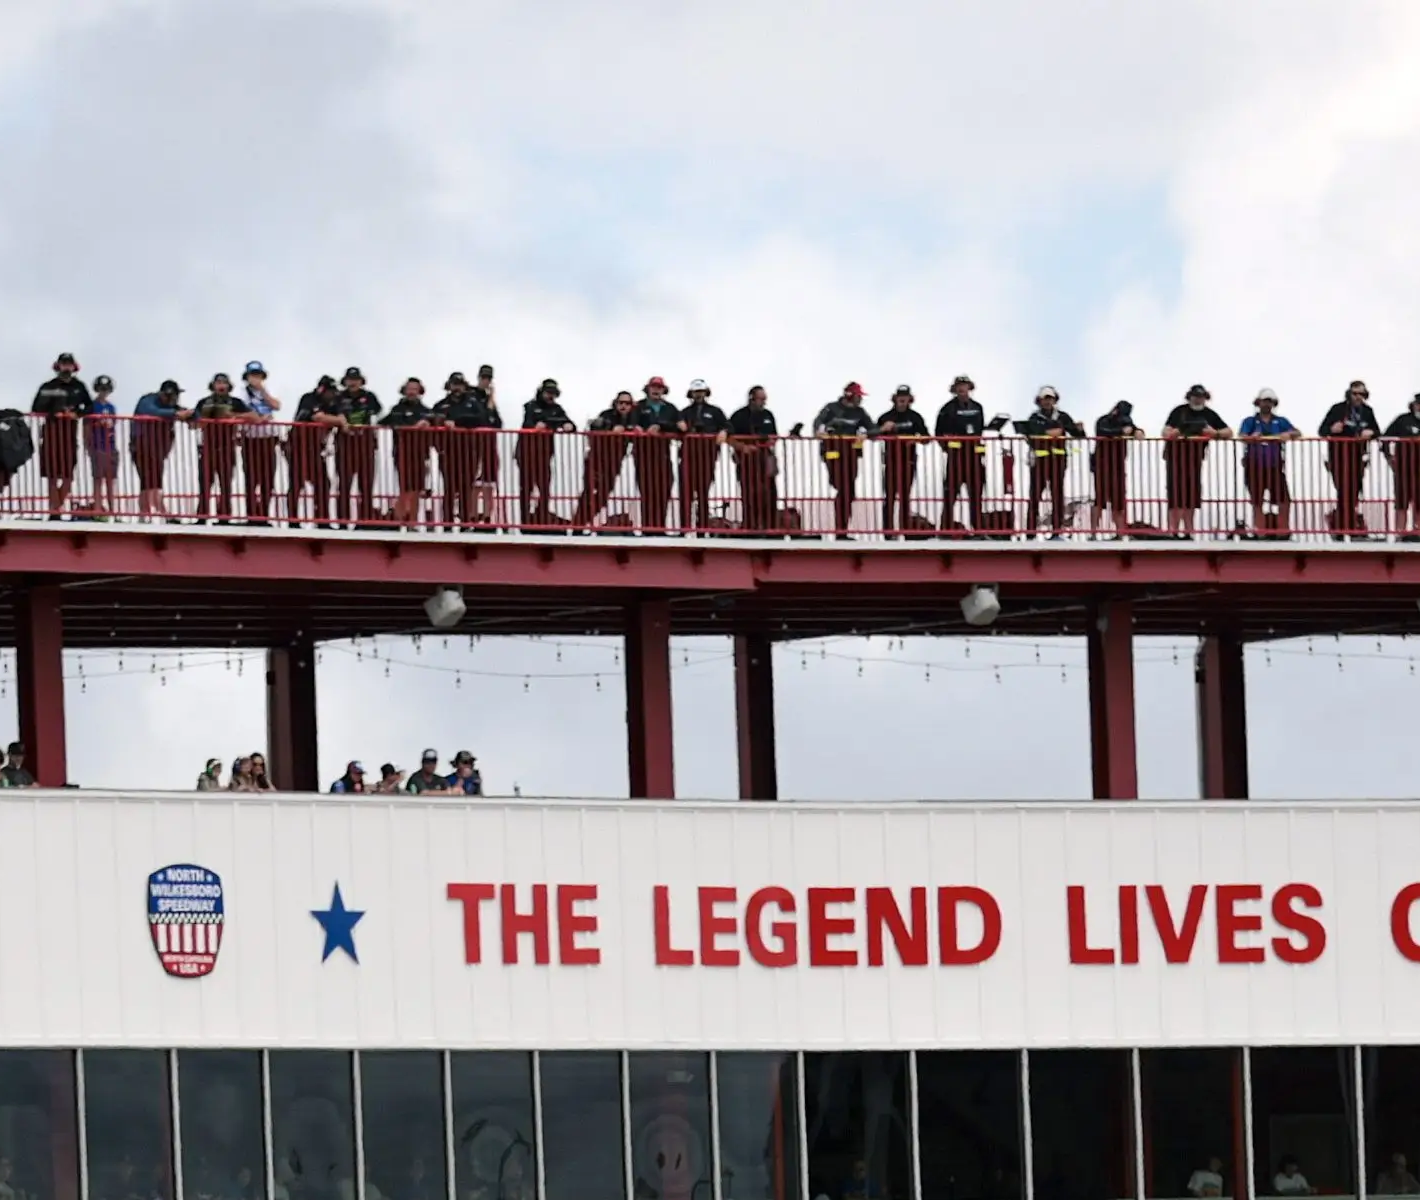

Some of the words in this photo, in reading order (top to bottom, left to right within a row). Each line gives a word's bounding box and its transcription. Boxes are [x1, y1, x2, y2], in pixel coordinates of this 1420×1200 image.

[446, 883, 601, 967] THE
[654, 884, 1002, 968] LEGEND
[1066, 883, 1327, 966] LIVES
